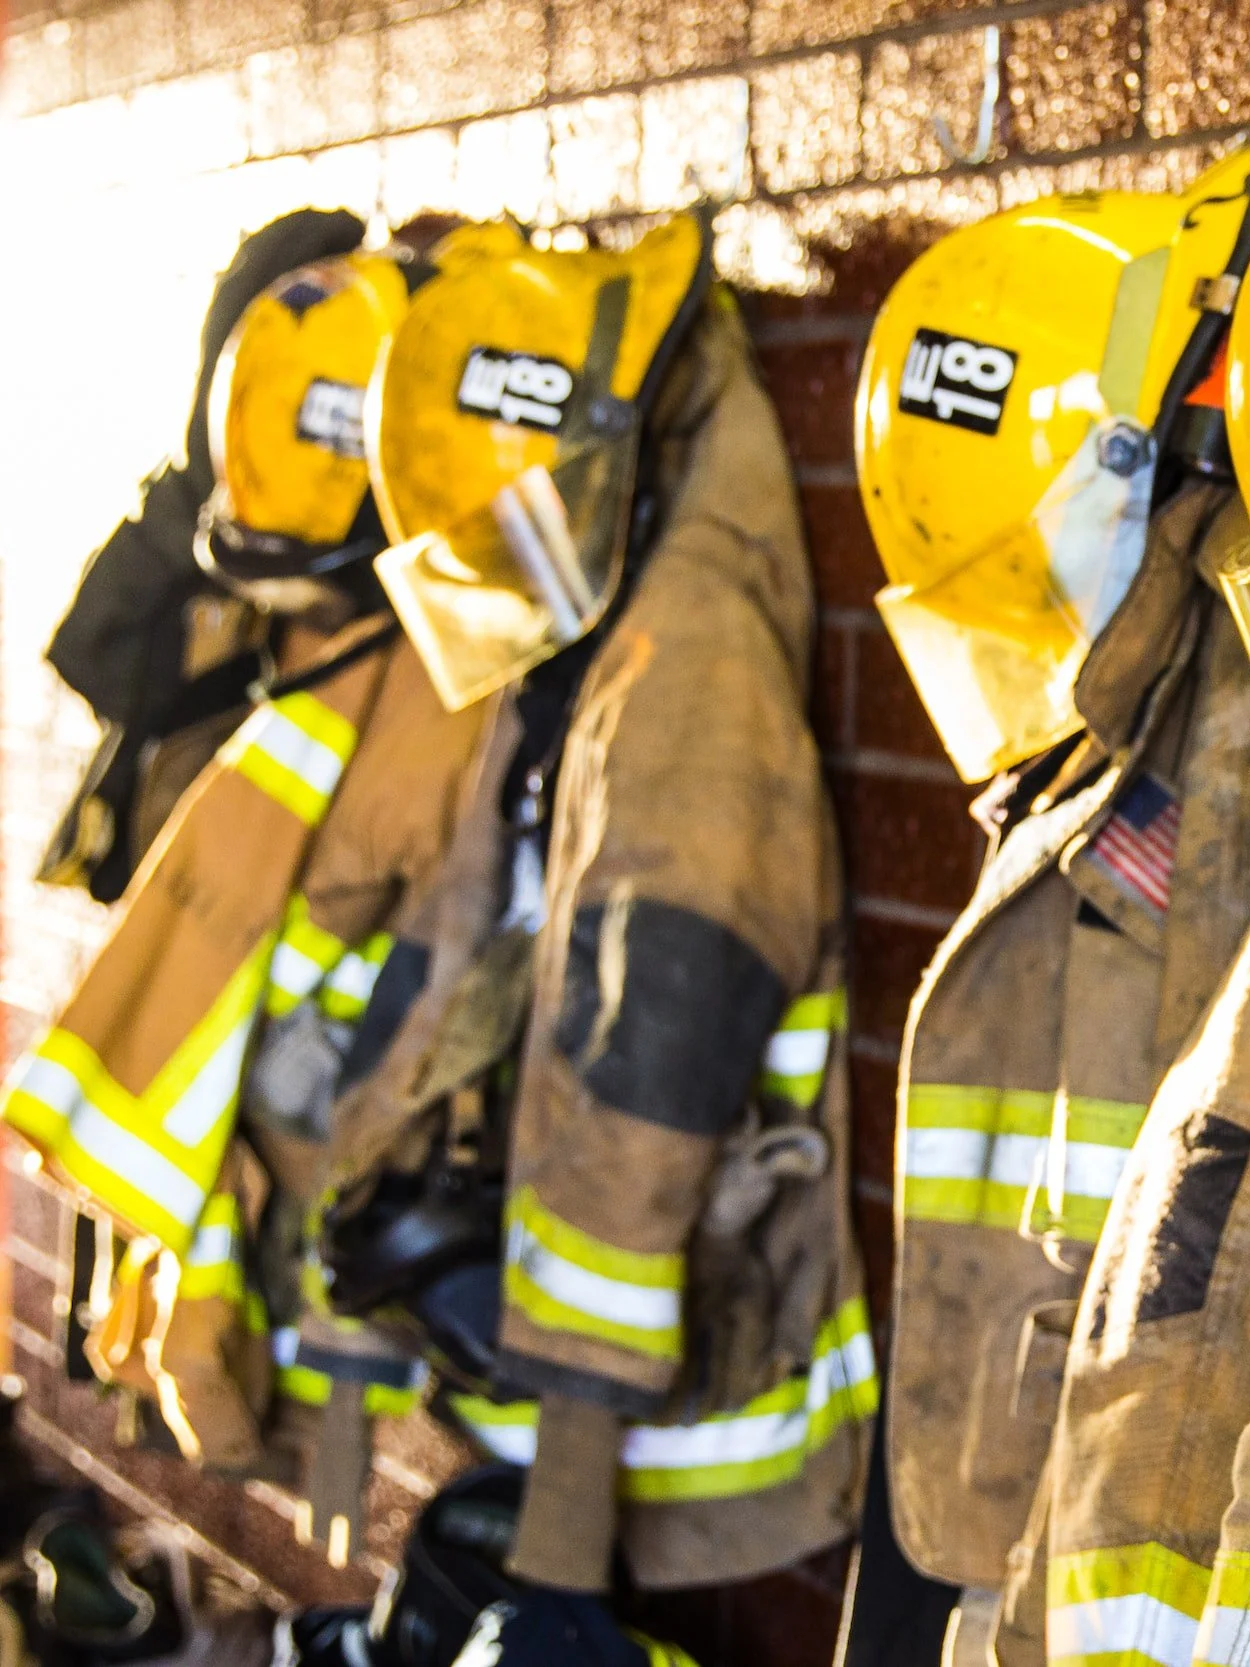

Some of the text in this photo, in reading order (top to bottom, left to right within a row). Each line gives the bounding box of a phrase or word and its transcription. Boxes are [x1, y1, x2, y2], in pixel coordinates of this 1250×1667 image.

[500, 358, 573, 427] 18
[901, 338, 943, 403] E
[933, 341, 1015, 421] 18
